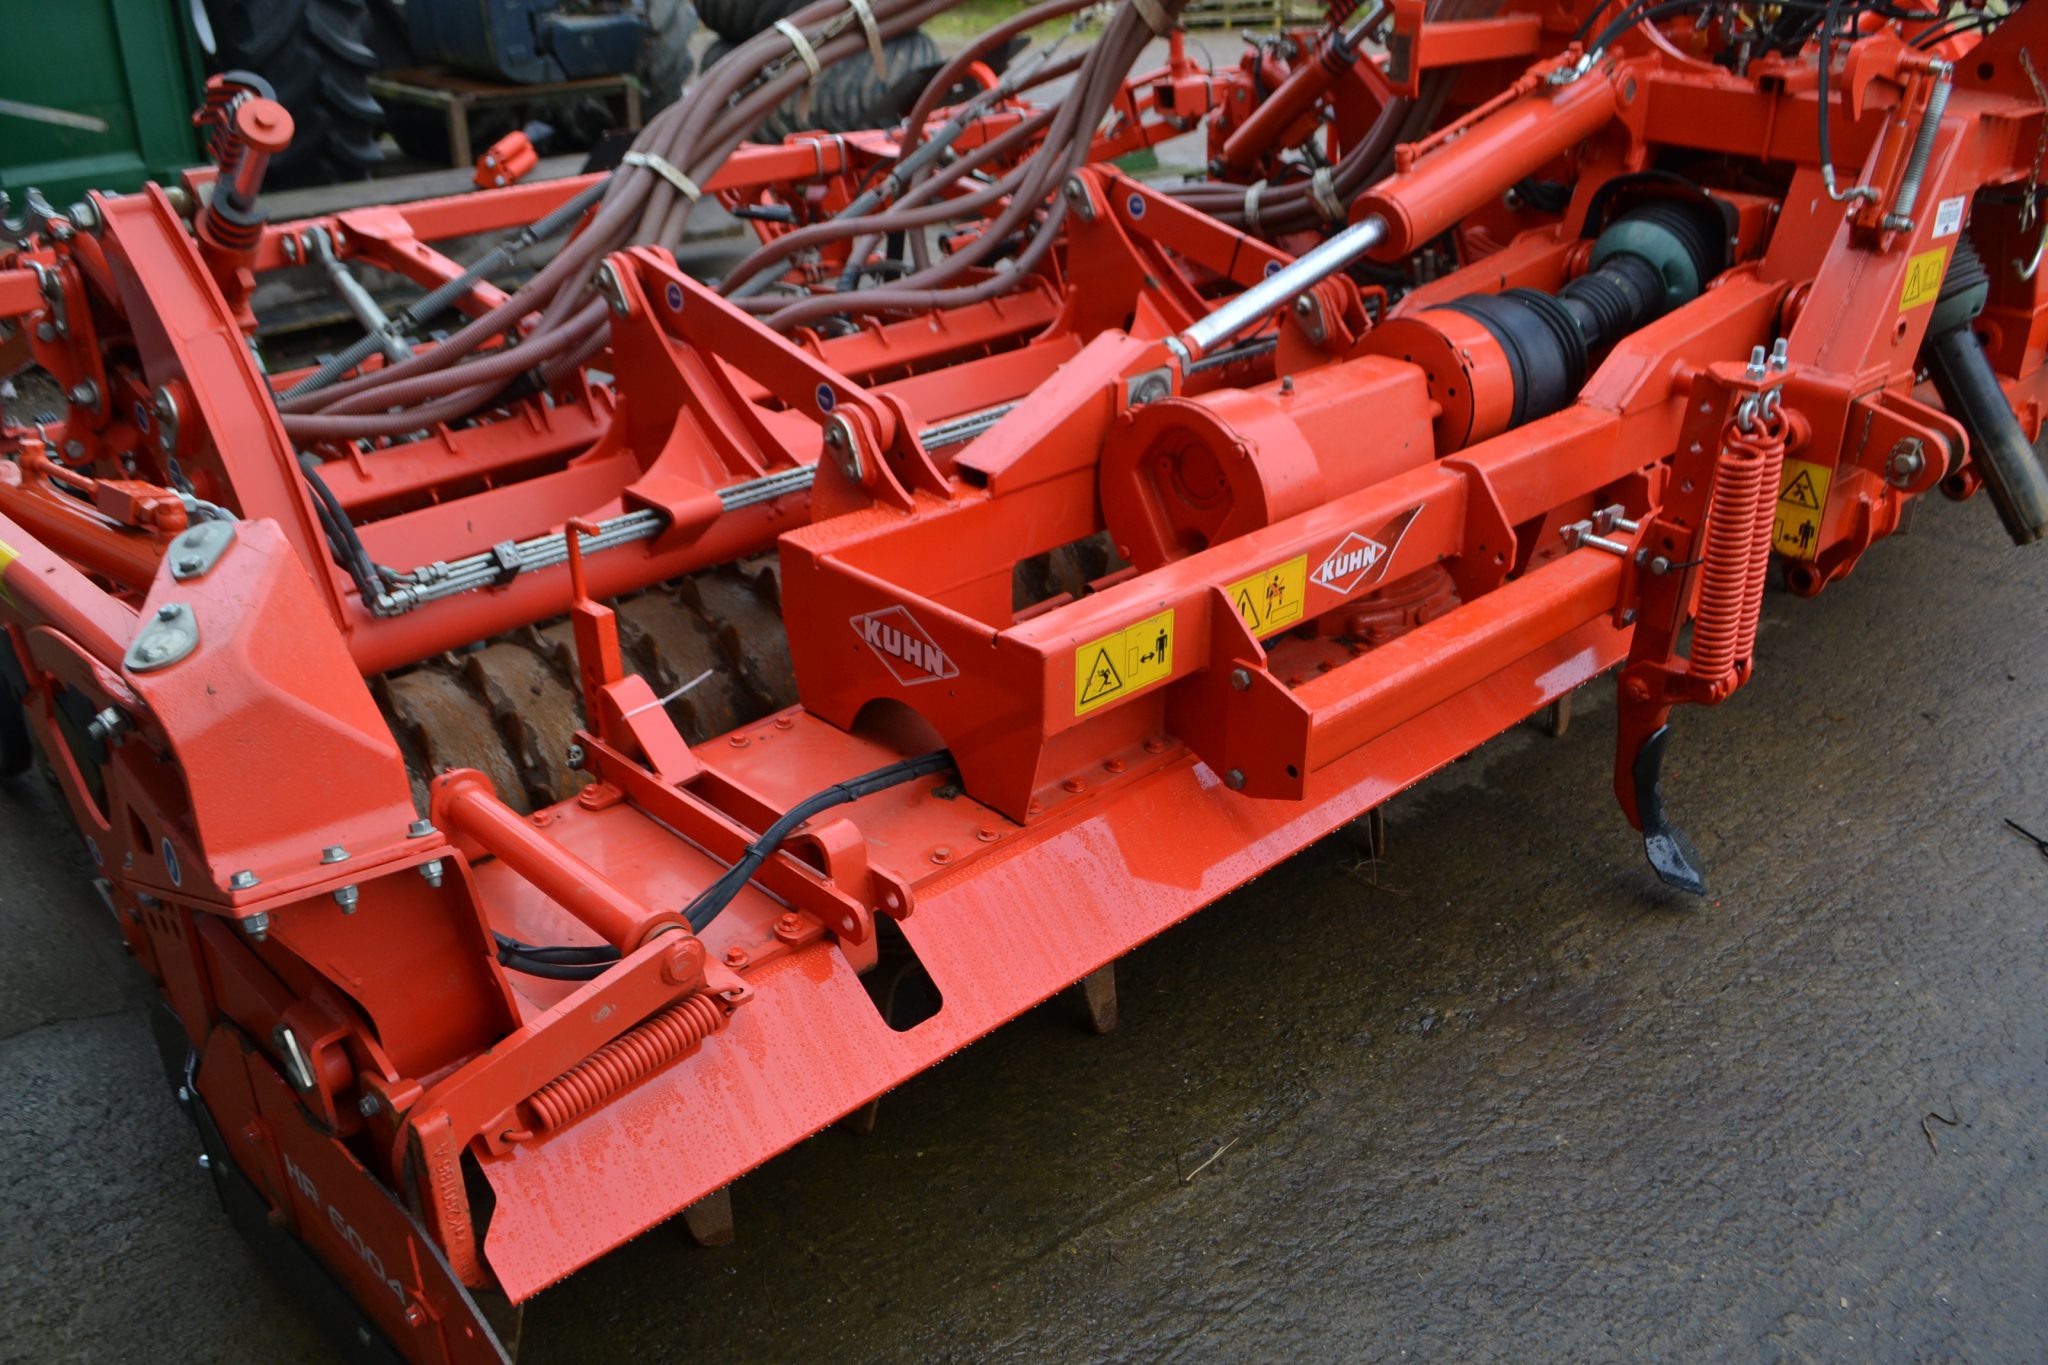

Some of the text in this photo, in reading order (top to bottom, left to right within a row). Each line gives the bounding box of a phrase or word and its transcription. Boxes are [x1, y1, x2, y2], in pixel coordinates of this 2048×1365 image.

[1321, 543, 1377, 584] KUHN
[863, 615, 944, 678] KUHN
[284, 1153, 406, 1306] HR 6004
